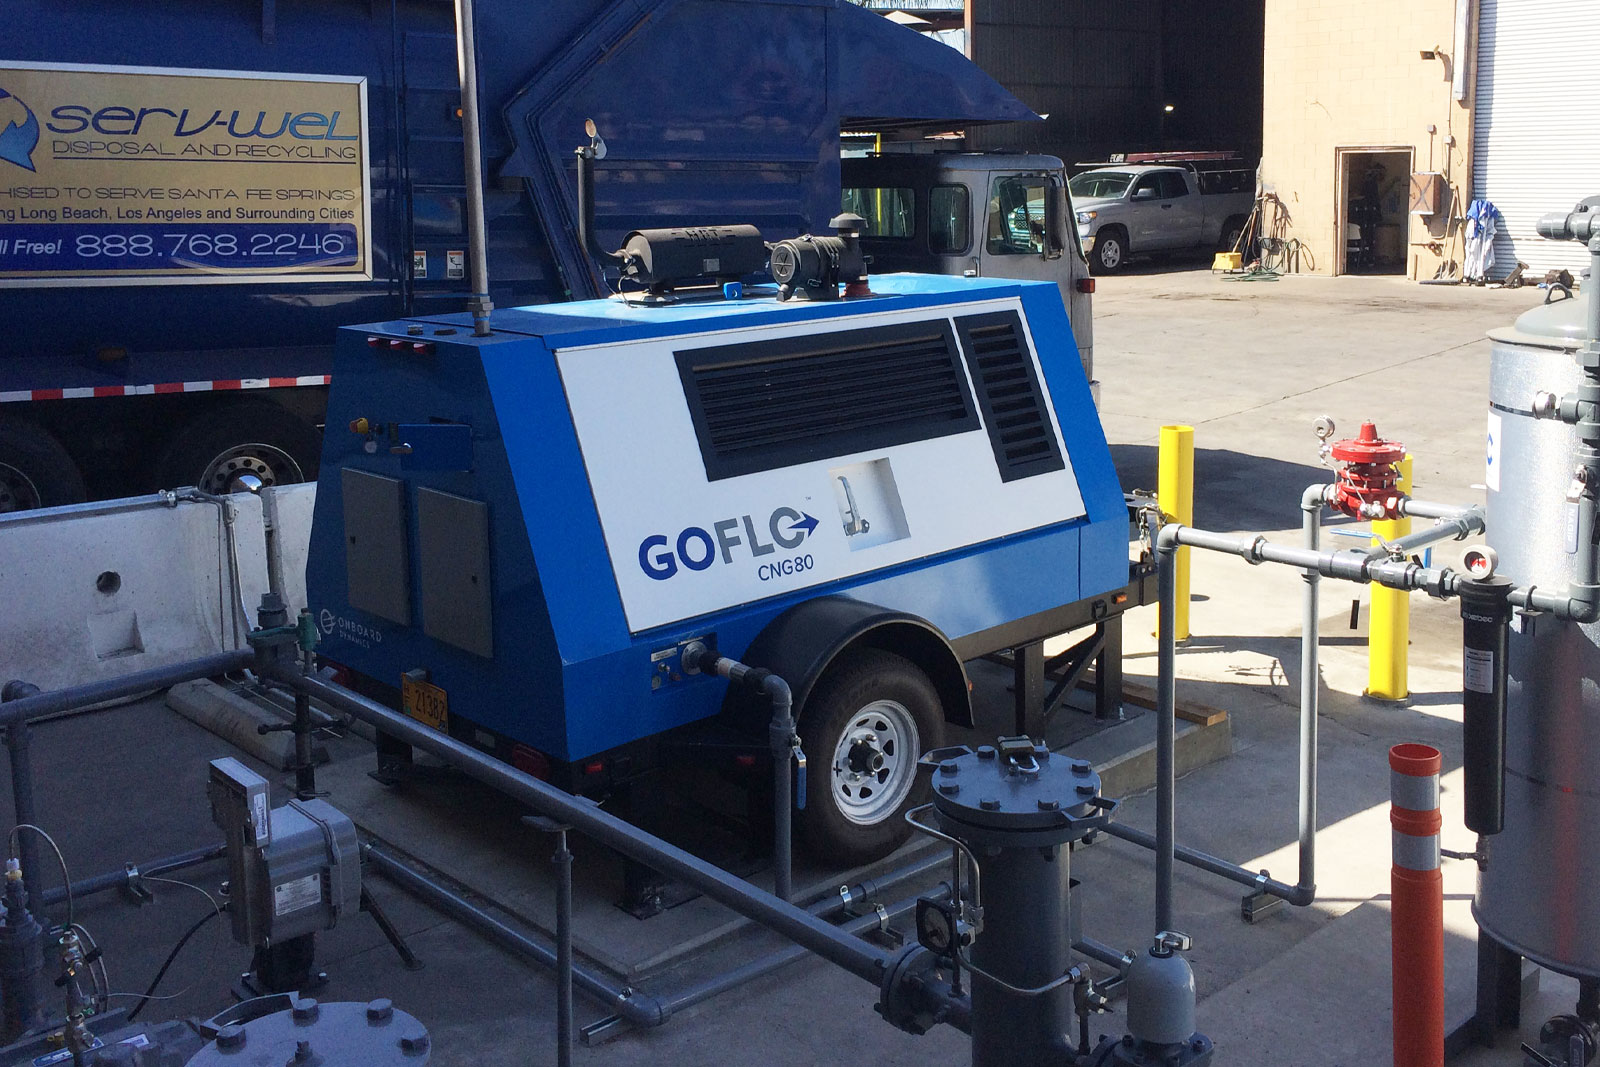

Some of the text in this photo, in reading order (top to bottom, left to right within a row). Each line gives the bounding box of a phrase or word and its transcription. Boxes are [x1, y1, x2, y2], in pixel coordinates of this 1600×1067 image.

[53, 140, 356, 159] DISPOSAL AND RECYCLING
[64, 187, 92, 199] TO
[95, 188, 164, 200] SERVE
[168, 188, 239, 200] SANTA
[246, 189, 272, 200] FE
[276, 189, 355, 201] SPRINGS
[20, 207, 57, 222] Long
[62, 206, 112, 220] Beach,
[118, 207, 142, 219] Los
[146, 207, 201, 221] Angeles
[206, 207, 231, 219] and
[236, 207, 315, 221] Surrounding
[319, 207, 354, 219] Cities
[13, 239, 62, 255] Free!
[75, 233, 344, 258] 888.768.2246
[758, 553, 814, 582] CNG80
[338, 616, 382, 643] ONBOARD
